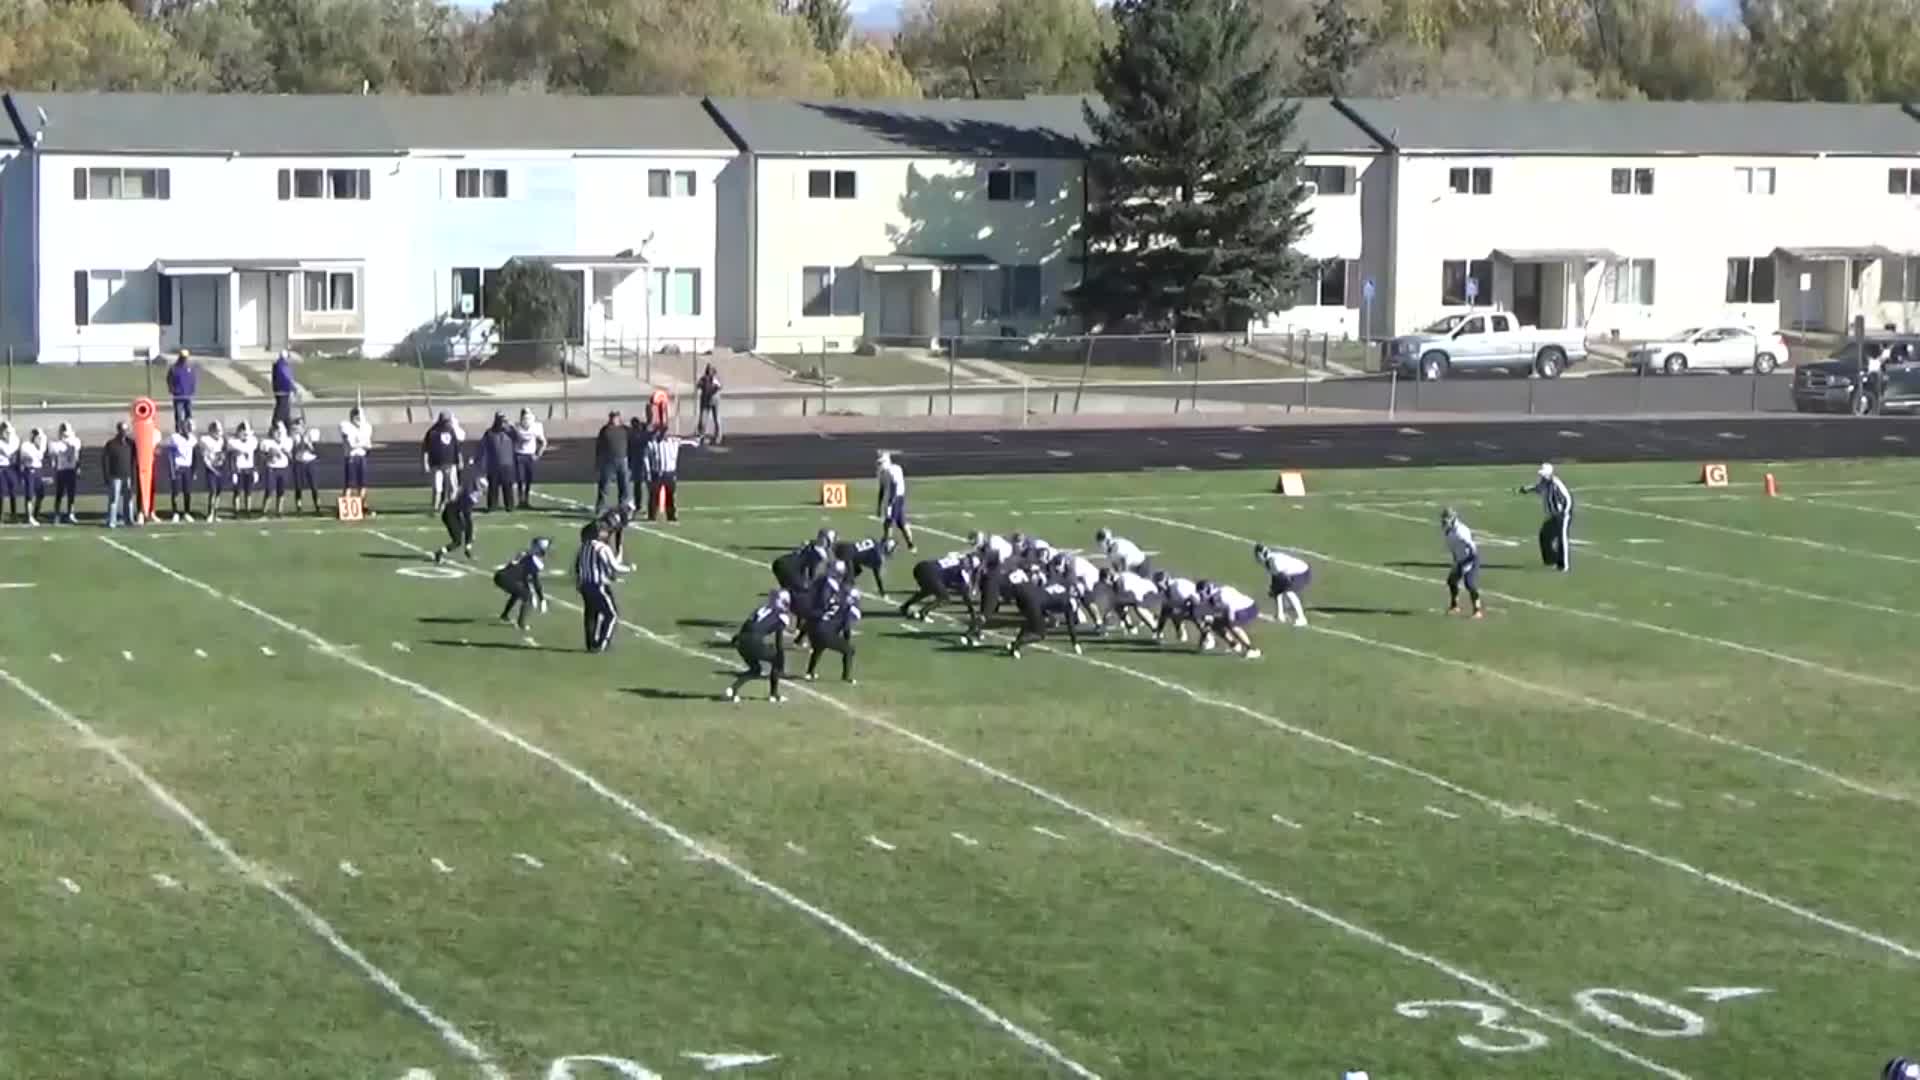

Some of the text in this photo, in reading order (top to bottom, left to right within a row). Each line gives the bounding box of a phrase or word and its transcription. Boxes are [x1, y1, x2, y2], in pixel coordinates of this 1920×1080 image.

[1711, 466, 1725, 482] G
[826, 487, 843, 505] 20
[341, 498, 359, 517] 30
[1395, 987, 1705, 1053] 30
